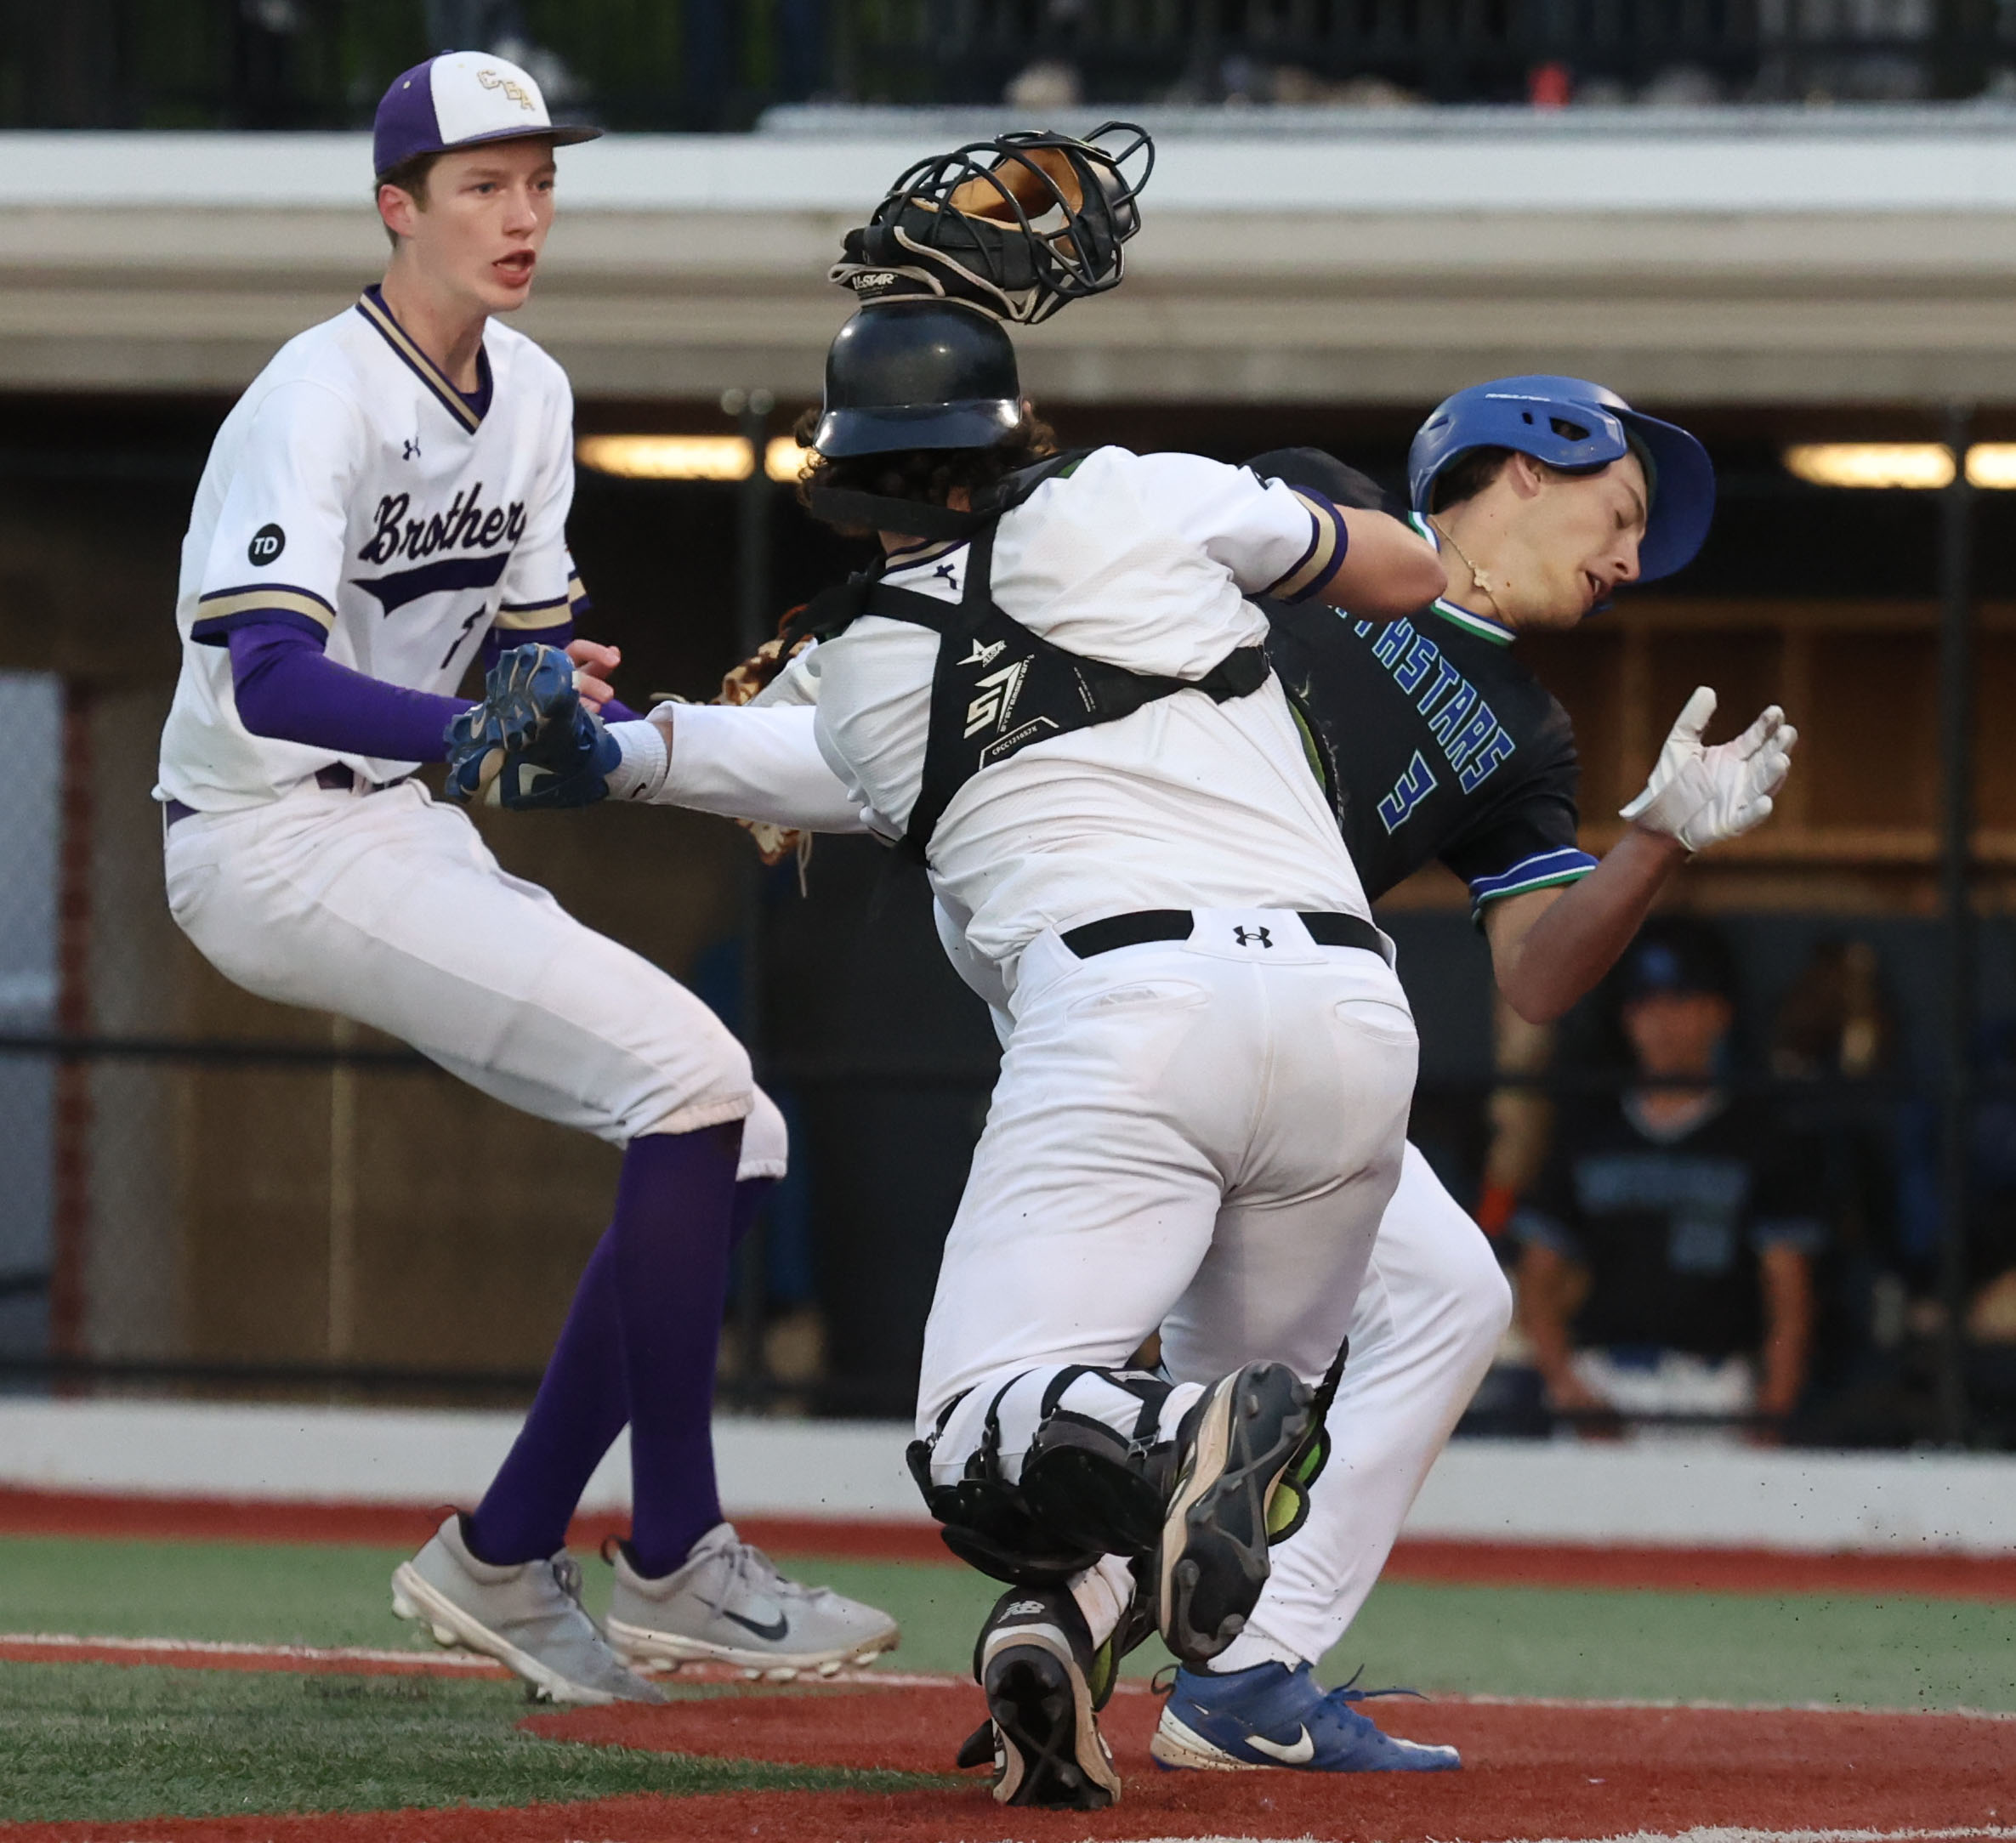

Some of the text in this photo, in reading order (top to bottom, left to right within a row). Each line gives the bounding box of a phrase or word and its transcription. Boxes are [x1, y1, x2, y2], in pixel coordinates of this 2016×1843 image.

[253, 536, 279, 556] TD
[1335, 605, 1516, 795] HSTARS
[1377, 748, 1438, 836] 3
